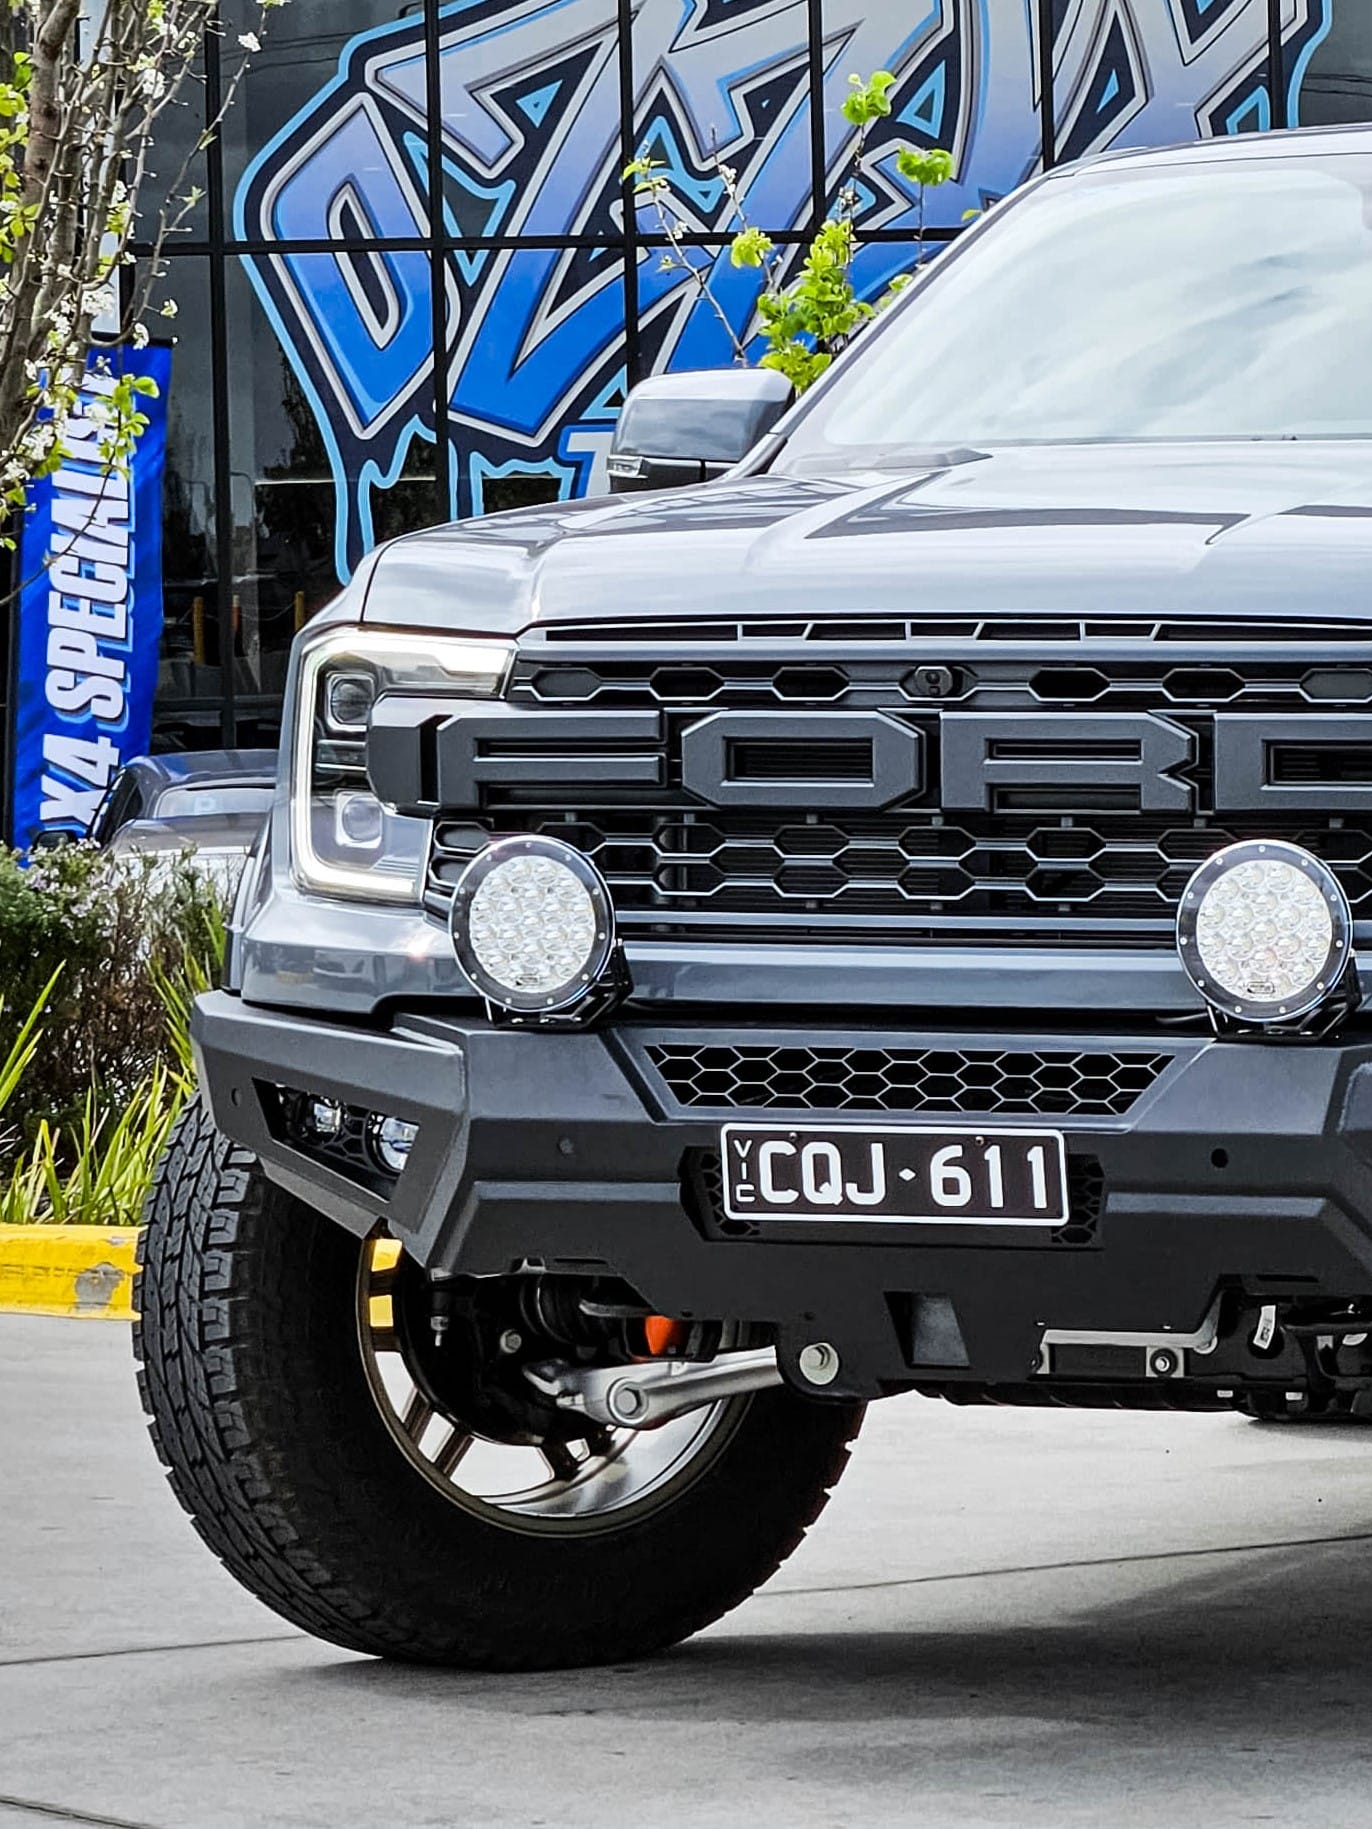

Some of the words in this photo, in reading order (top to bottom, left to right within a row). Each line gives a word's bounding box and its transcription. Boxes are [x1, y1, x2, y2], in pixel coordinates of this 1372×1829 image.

[734, 1139, 755, 1202] VIC
[759, 1140, 886, 1205] CQJ
[930, 1144, 1047, 1209] 611
